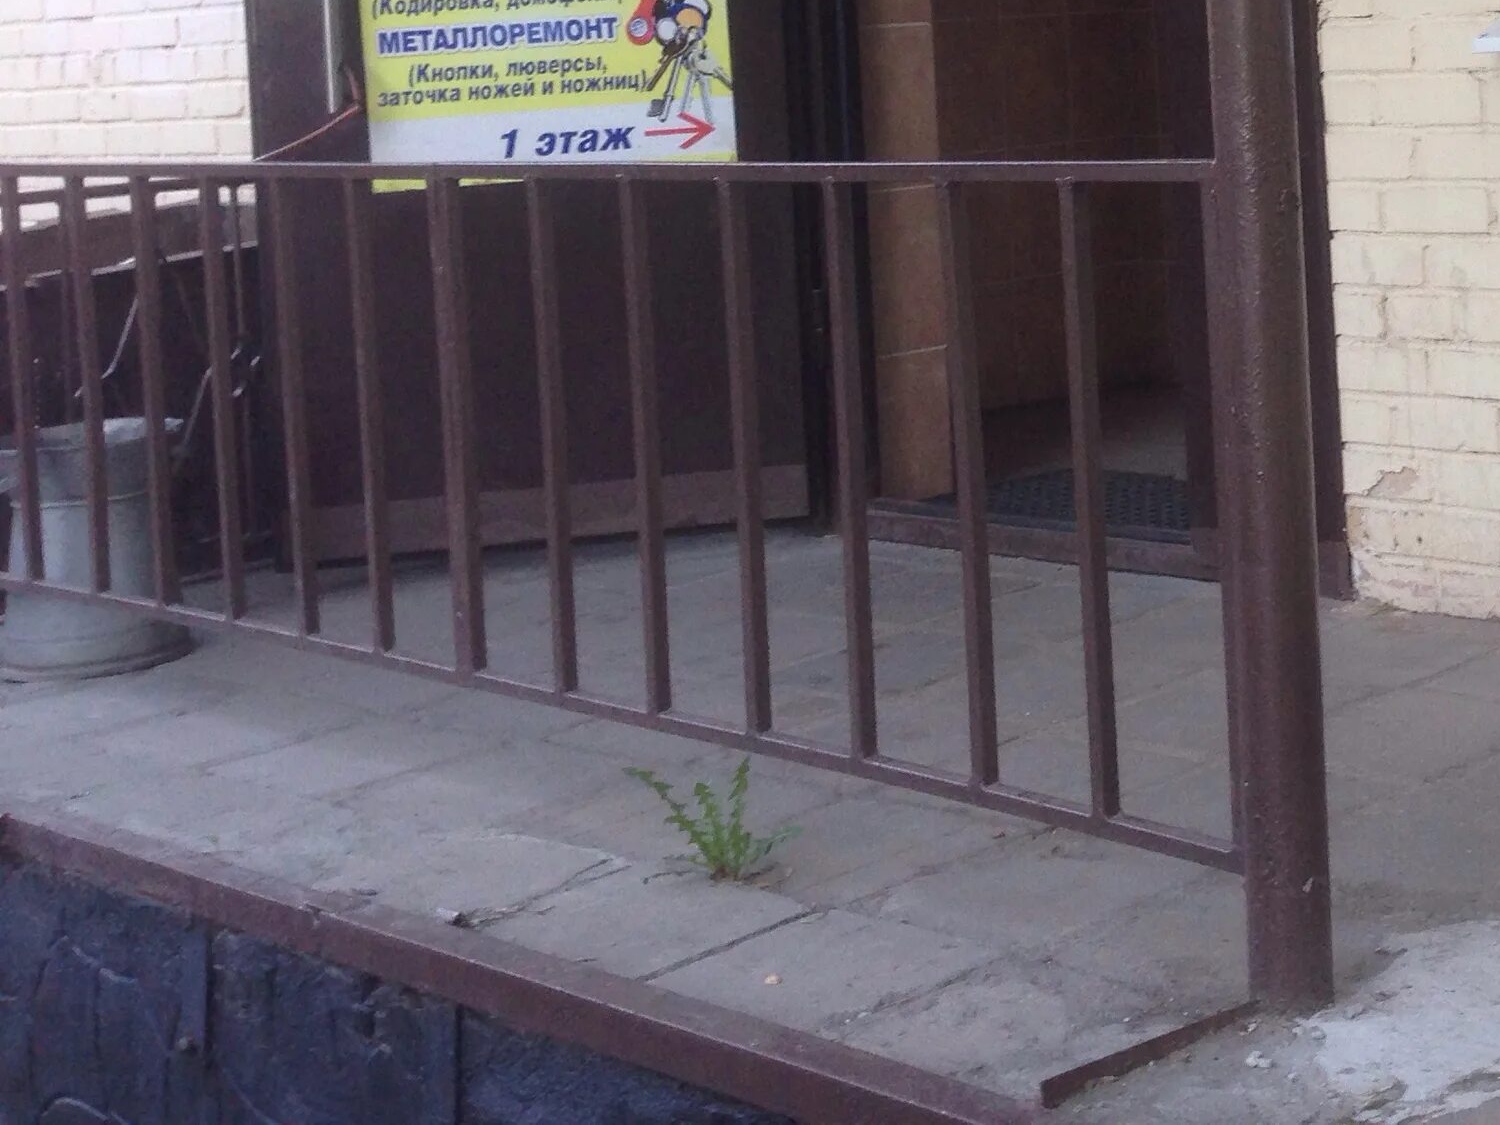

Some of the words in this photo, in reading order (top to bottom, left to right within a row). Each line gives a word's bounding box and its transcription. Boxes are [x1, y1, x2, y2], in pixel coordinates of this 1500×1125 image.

[378, 17, 617, 53] МЕТАЛЛОРЕМОНТ
[408, 63, 499, 87] (Кнопки,
[378, 89, 461, 107] заточка
[468, 78, 534, 100] ножей
[542, 82, 553, 95] и
[500, 129, 519, 159] 1
[535, 126, 635, 156] этаж
